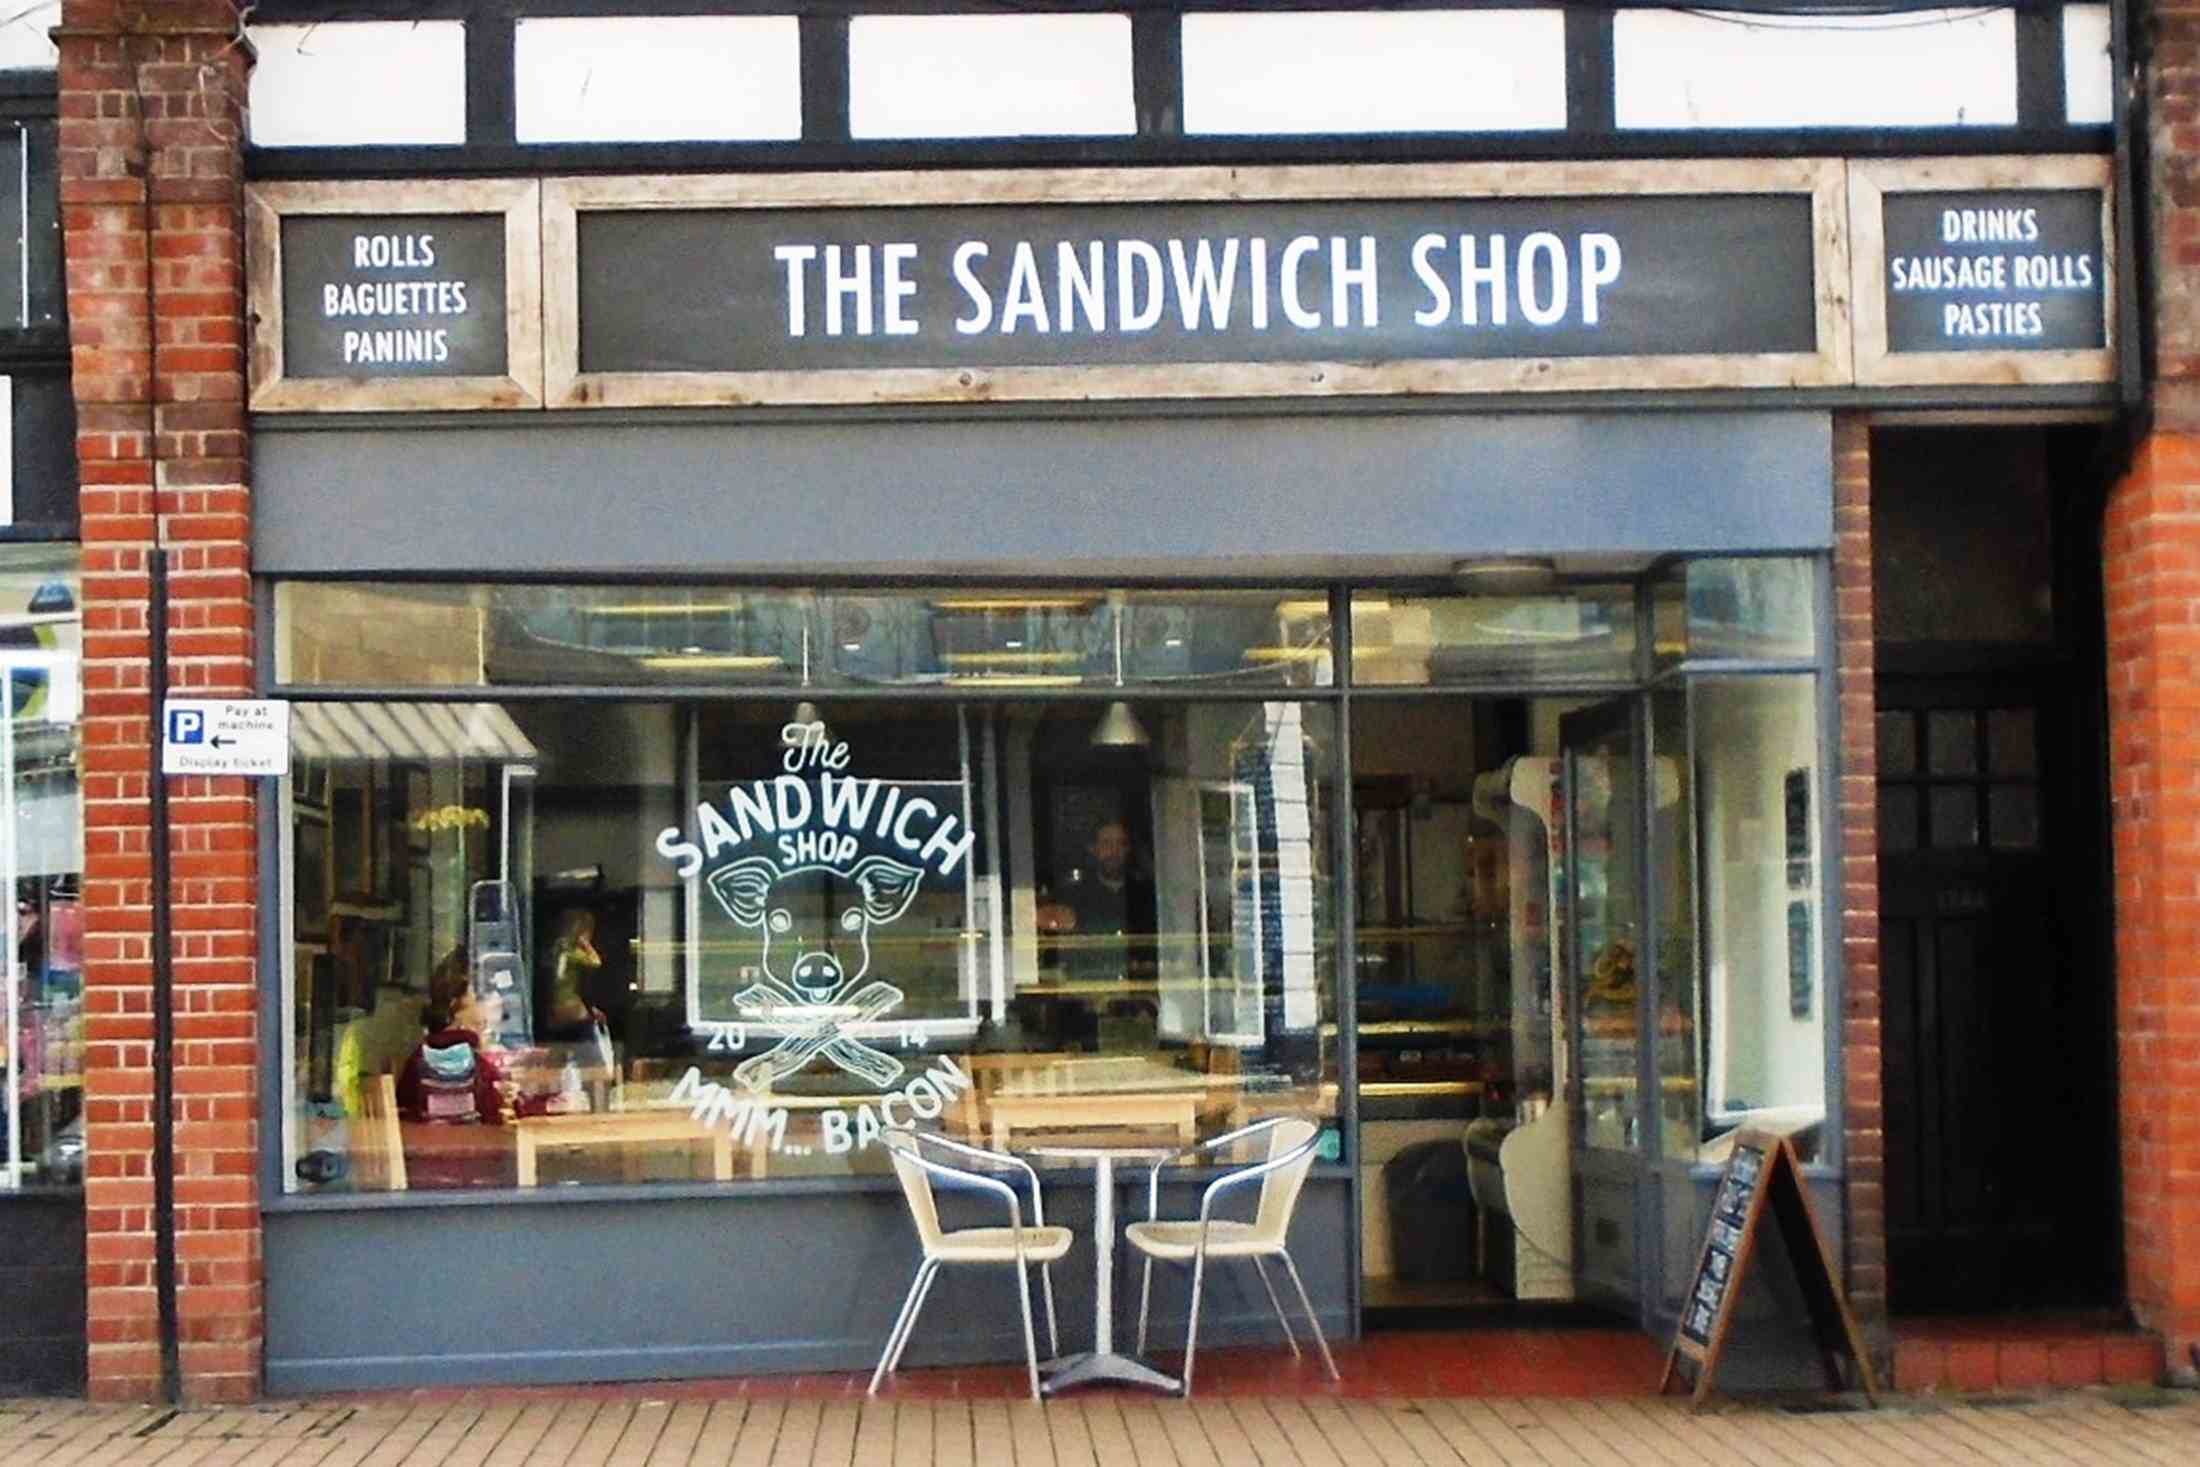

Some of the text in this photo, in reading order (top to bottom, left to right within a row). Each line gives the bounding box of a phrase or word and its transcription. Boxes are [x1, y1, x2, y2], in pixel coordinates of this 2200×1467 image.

[1943, 208, 2039, 242] DRINKS
[354, 234, 435, 268] ROLLS
[774, 231, 1622, 337] THE SANDWICH SHOP
[1892, 254, 2093, 289] SAUSAGE ROLLS
[323, 281, 468, 316] BAGUETTES
[1944, 302, 2043, 336] PASTIES
[344, 330, 448, 364] PANINIS
[176, 712, 201, 742] P
[218, 720, 274, 729] machine
[225, 705, 268, 717] Pay at
[179, 757, 272, 769] Display ticket
[781, 720, 851, 772] The
[656, 771, 976, 878] SANDWICH
[778, 831, 859, 866] SHOP
[707, 1026, 930, 1050] 20 14
[669, 1054, 973, 1156] MMM... BACON
